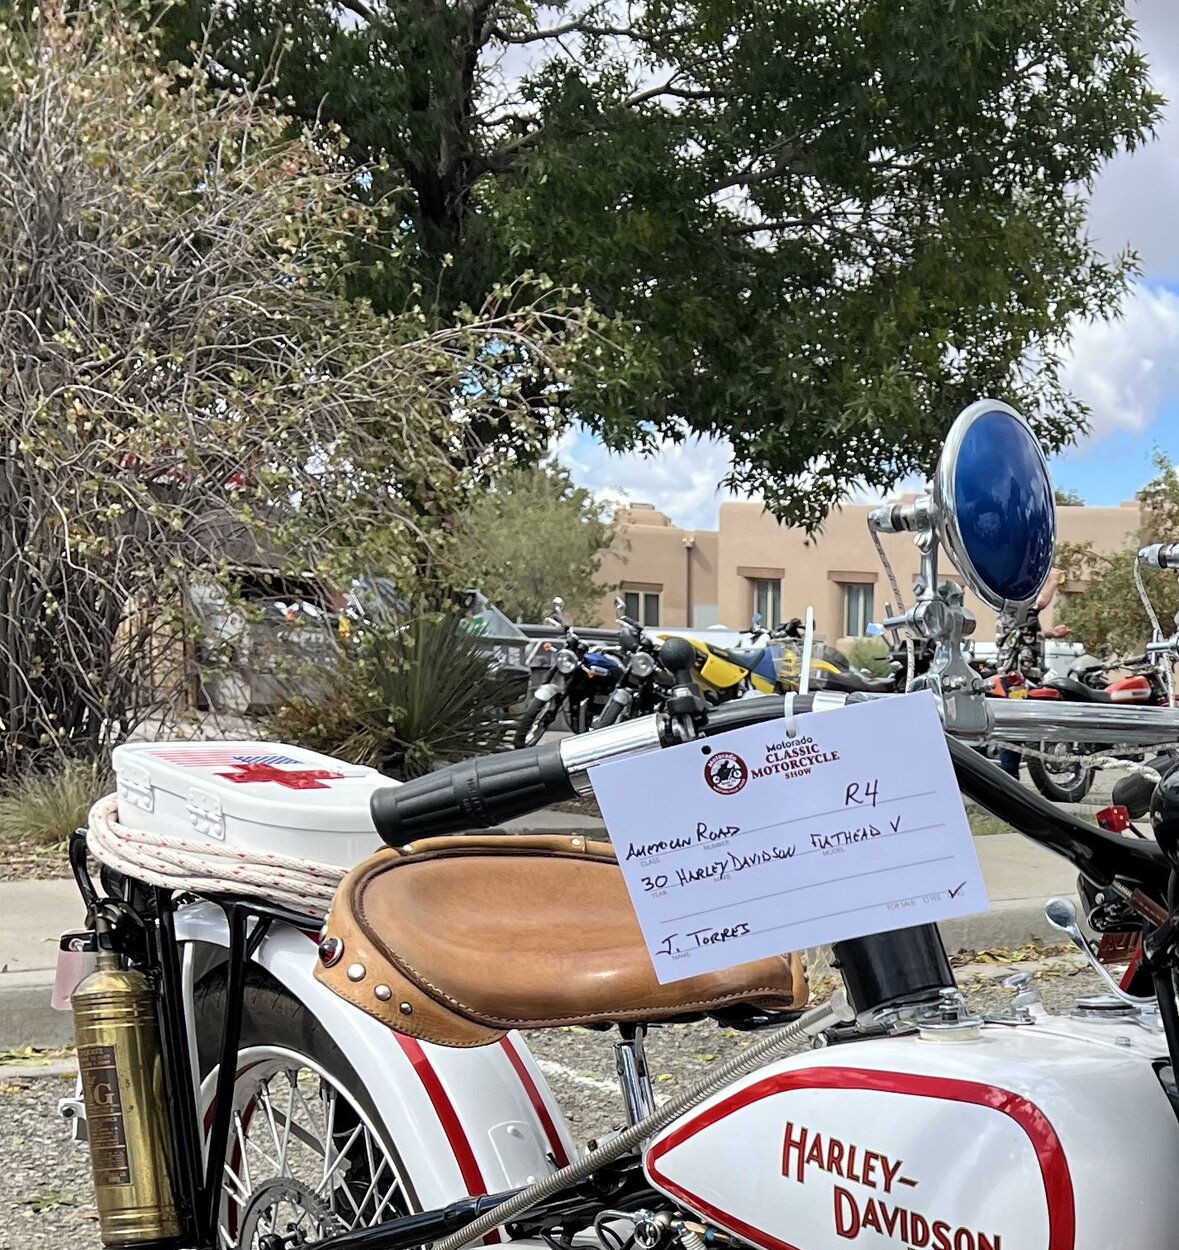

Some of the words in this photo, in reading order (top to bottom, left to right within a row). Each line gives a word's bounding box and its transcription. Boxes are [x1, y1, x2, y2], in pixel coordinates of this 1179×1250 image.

[765, 735, 813, 753] Motorado
[765, 743, 820, 764] CLASSIC
[750, 750, 840, 780] MOTORCYCLE
[784, 767, 812, 780] SHOW
[696, 822, 741, 842] ROAD
[640, 858, 660, 867] CLASS
[641, 875, 668, 891] 30
[675, 859, 729, 886] HARLEY
[727, 845, 796, 871] DAVIDSON
[650, 889, 668, 899] YEAR
[686, 922, 751, 947] TORRES
[781, 1120, 919, 1194] HARLEY-
